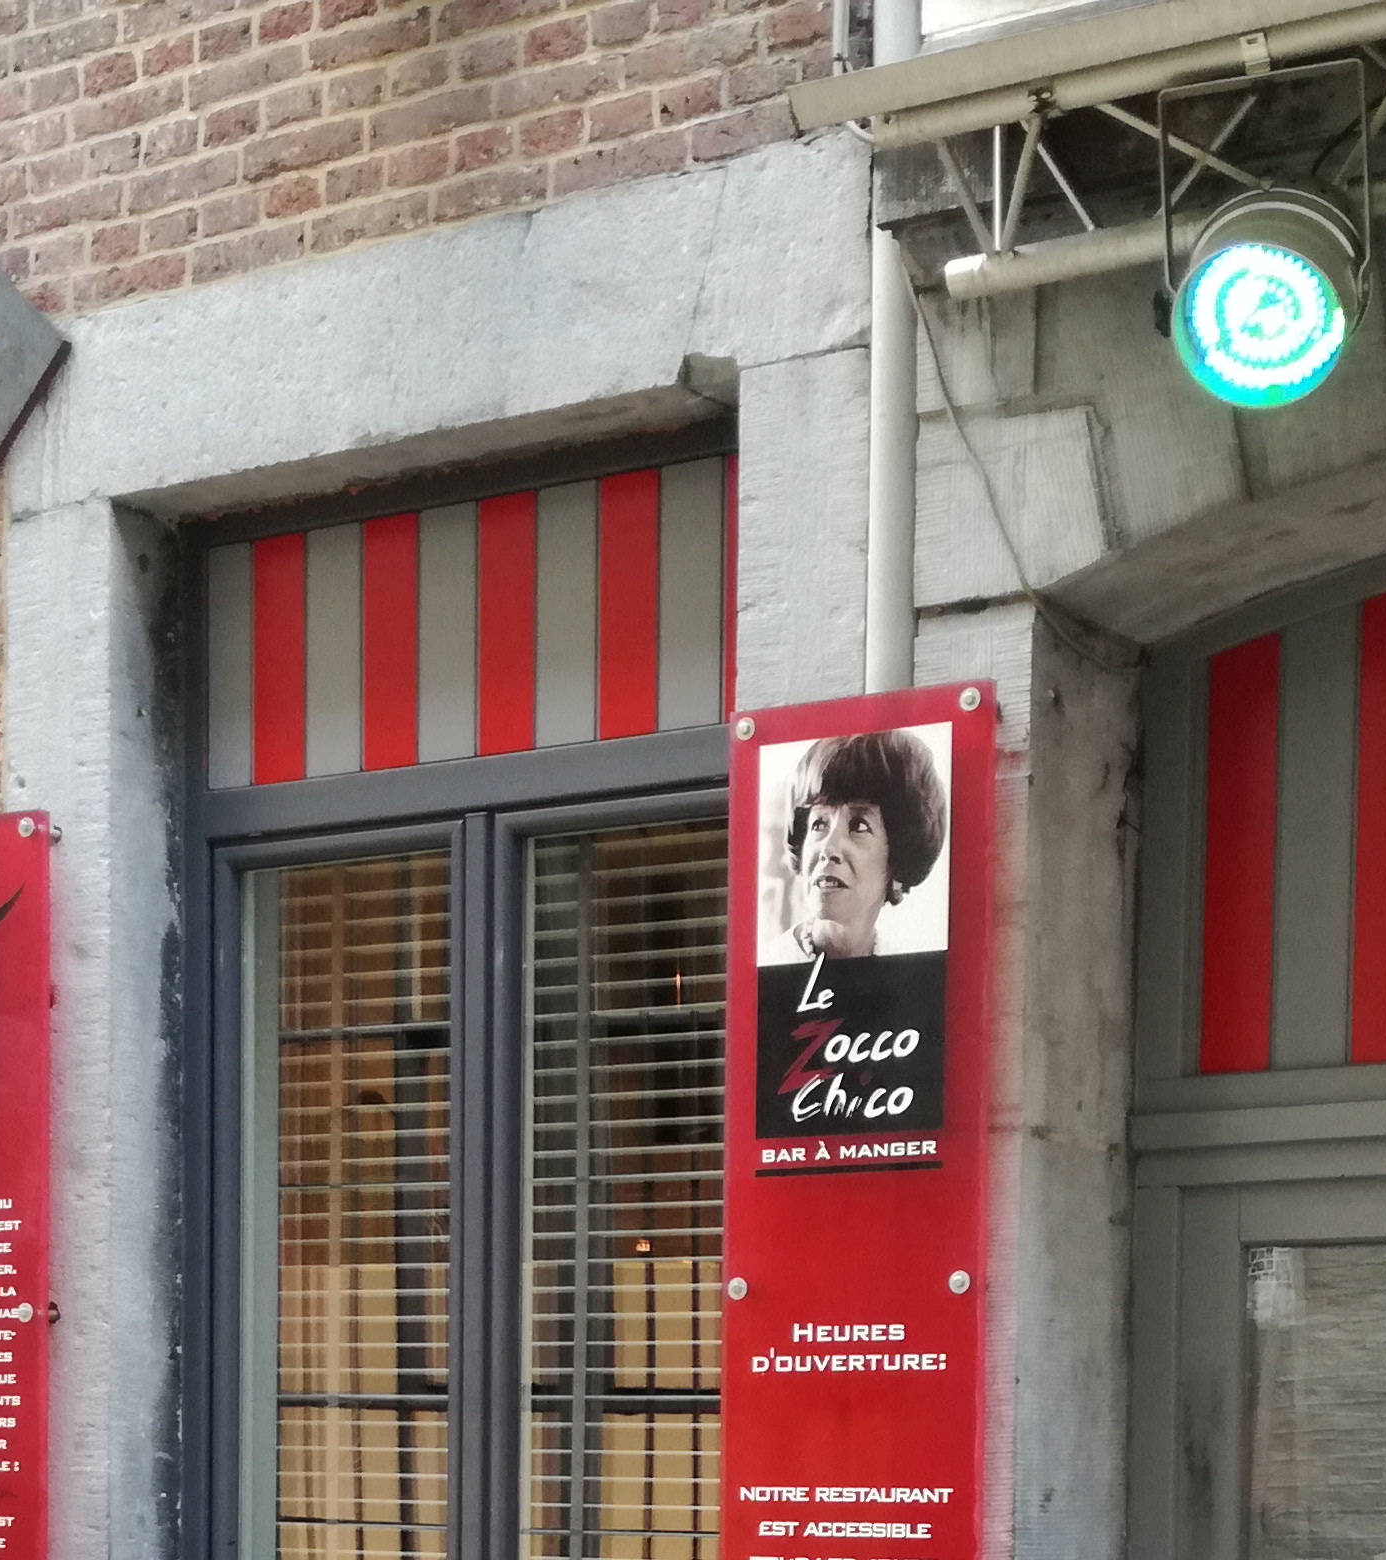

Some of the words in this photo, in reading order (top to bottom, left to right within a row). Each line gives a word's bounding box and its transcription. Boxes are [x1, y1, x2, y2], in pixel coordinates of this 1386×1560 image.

[761, 1147, 807, 1164] BAR
[814, 1141, 831, 1161] À
[839, 1140, 937, 1160] MANGER
[792, 1322, 905, 1343] HEURES
[739, 1486, 810, 1502] NOTRE
[814, 1486, 954, 1504] RESTAURANT
[758, 1520, 800, 1537] EST
[802, 1521, 932, 1539] ACCESSIBLE
